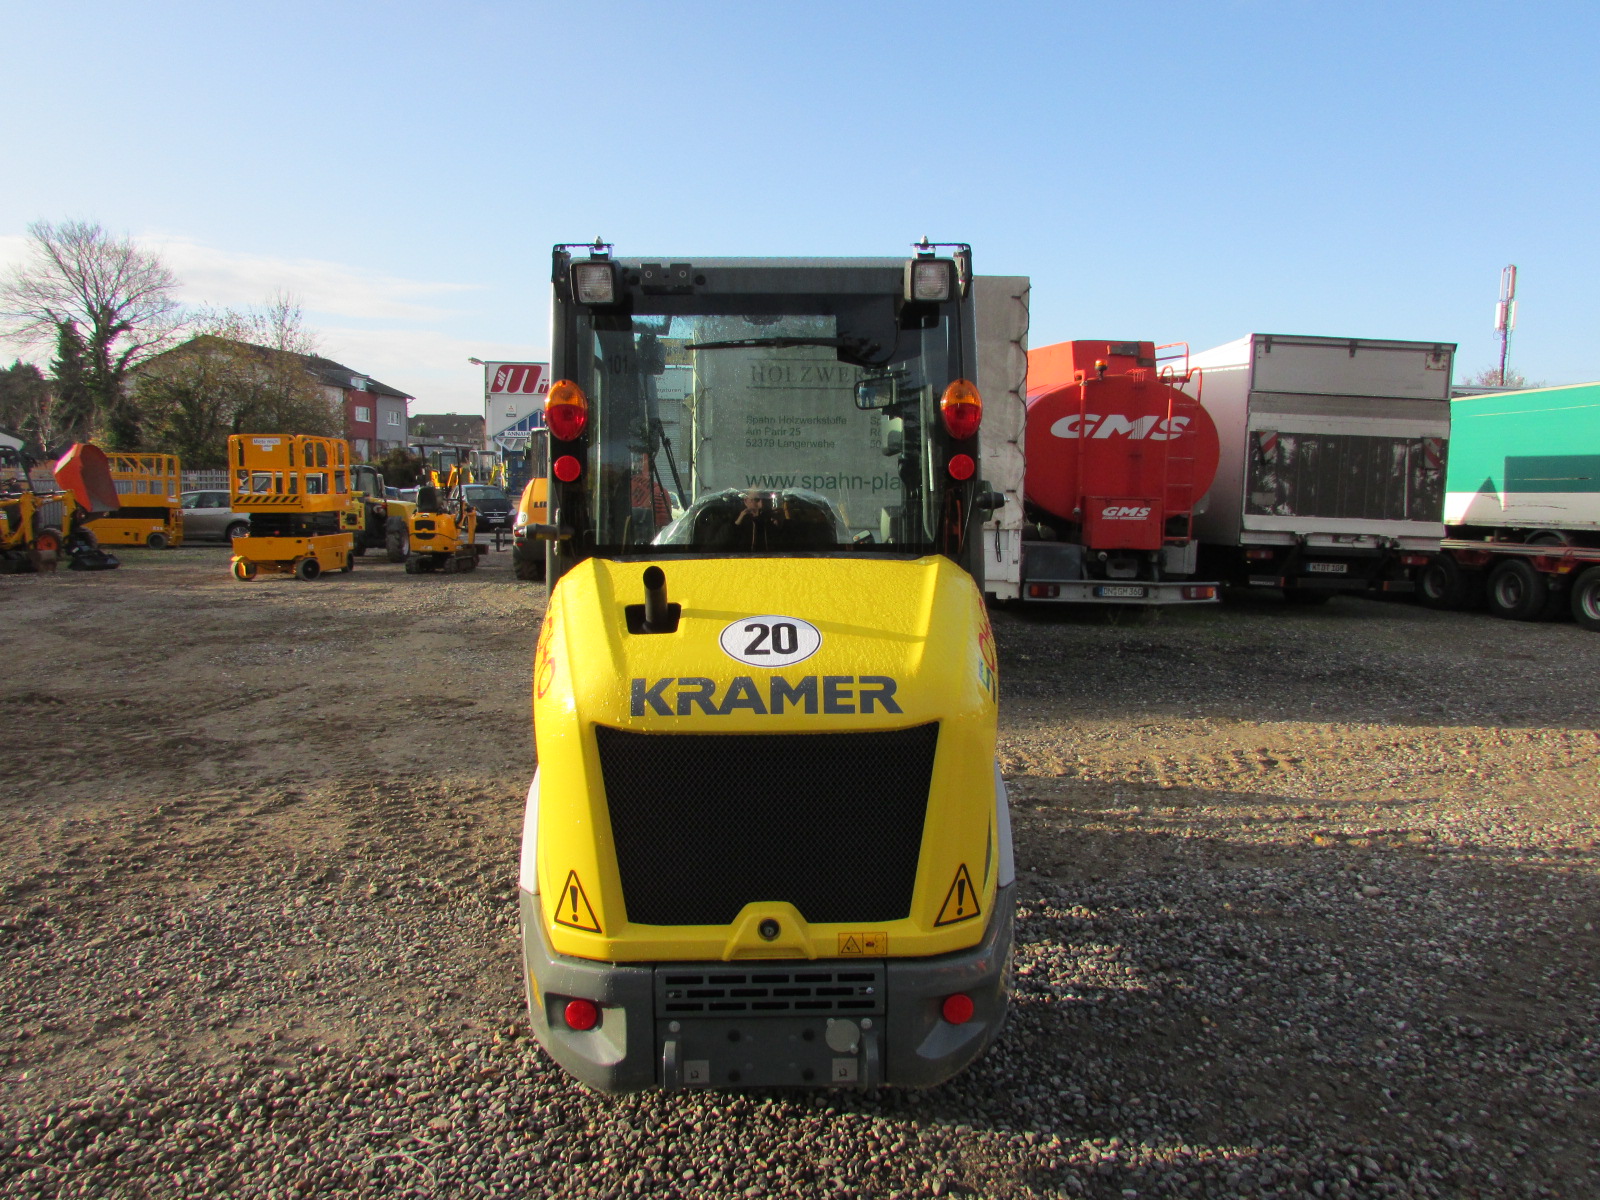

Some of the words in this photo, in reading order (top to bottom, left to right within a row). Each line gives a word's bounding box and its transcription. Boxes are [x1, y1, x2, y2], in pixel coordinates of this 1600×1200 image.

[746, 416, 775, 425] Spahn
[778, 415, 847, 425] Holzwerkstoffe
[789, 427, 801, 436] 25
[1050, 413, 1190, 441] GMS
[745, 438, 775, 448] 52379
[777, 438, 835, 449] Langerwehe
[1101, 506, 1151, 517] GMS
[743, 622, 798, 656] 20
[630, 675, 903, 717] KRAMER
